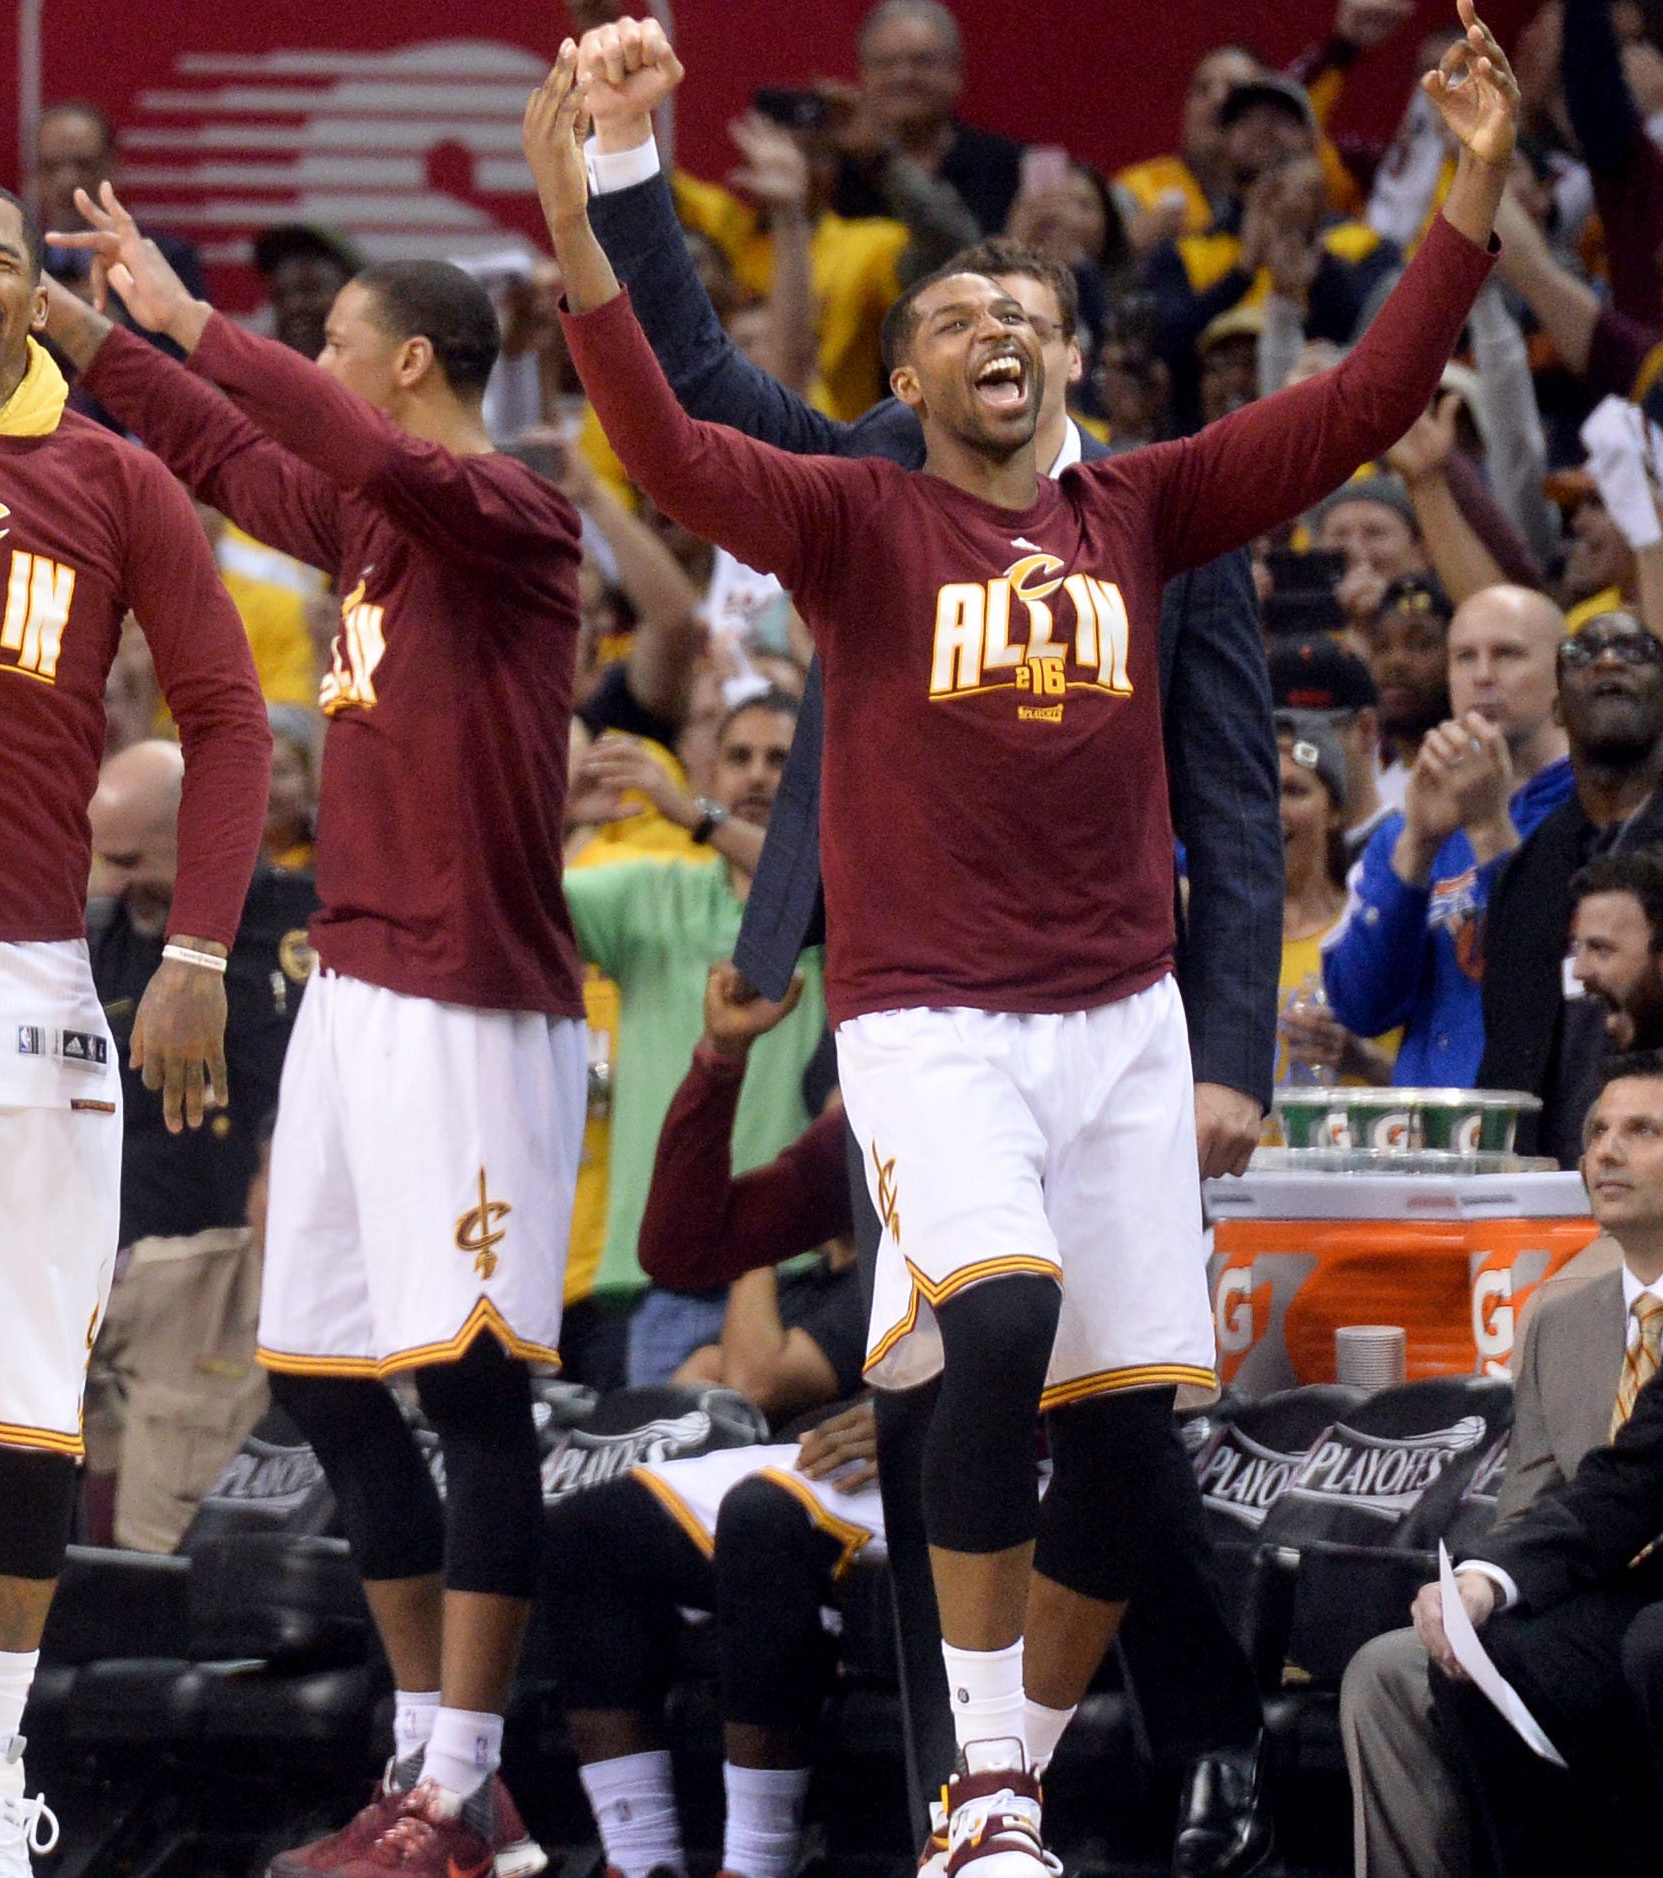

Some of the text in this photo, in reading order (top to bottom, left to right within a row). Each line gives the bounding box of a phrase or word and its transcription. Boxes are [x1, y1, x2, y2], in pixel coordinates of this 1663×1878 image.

[0, 549, 76, 678] IN
[929, 572, 1135, 694] ALL IN
[1015, 656, 1067, 696] 216
[1218, 1267, 1253, 1352] G
[1473, 1268, 1515, 1355] G
[1197, 1445, 1289, 1507] PLAYO
[1296, 1441, 1456, 1496] PLAYOFFS
